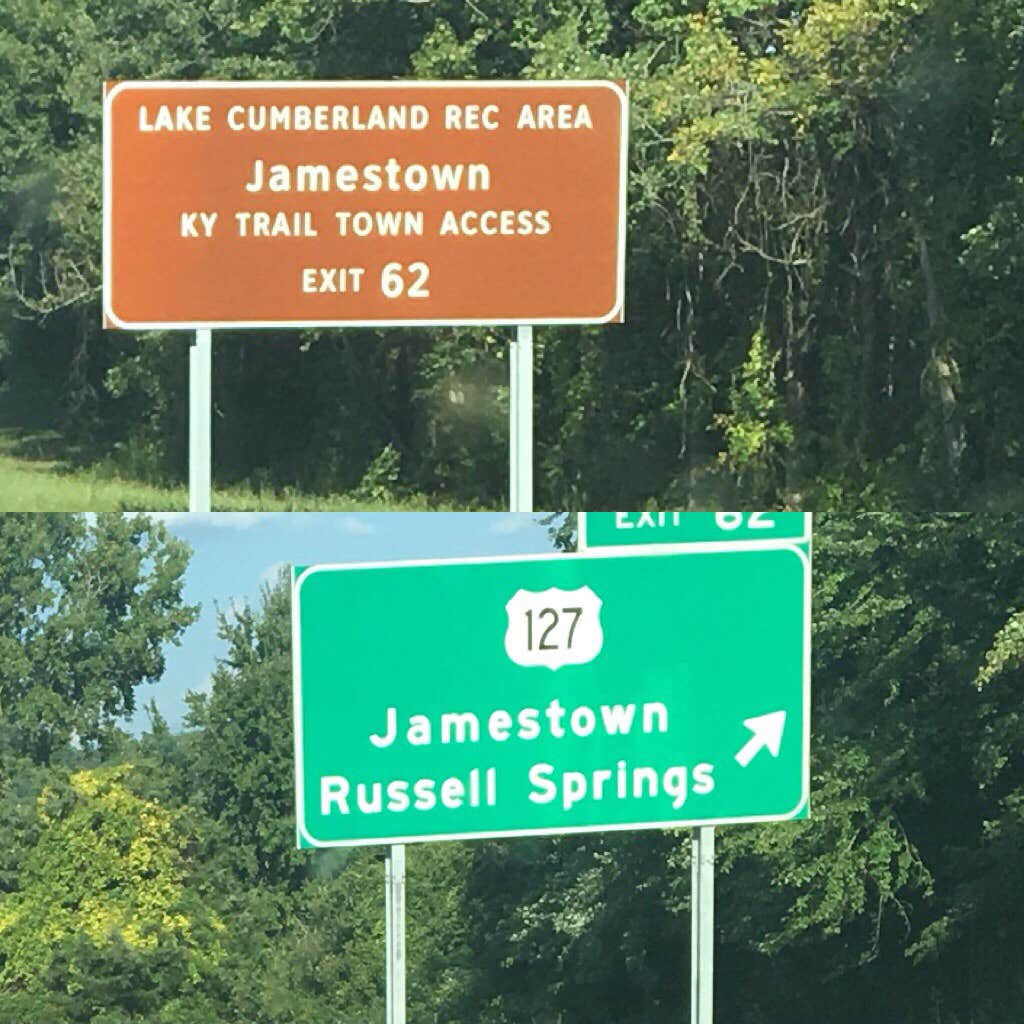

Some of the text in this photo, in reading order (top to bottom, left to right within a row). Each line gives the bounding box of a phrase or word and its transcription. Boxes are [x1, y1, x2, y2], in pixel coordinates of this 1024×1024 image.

[138, 103, 594, 132] LAKE CUMBERLAND REC AREA
[245, 158, 491, 193] Jamestown
[180, 210, 552, 238] KY TRAIL TOWN ACCESS
[302, 262, 430, 298] EXIT 62
[715, 512, 776, 531] 62
[524, 607, 584, 652] 127
[369, 699, 669, 748] Jamestown
[320, 760, 715, 816] Russell Springs
